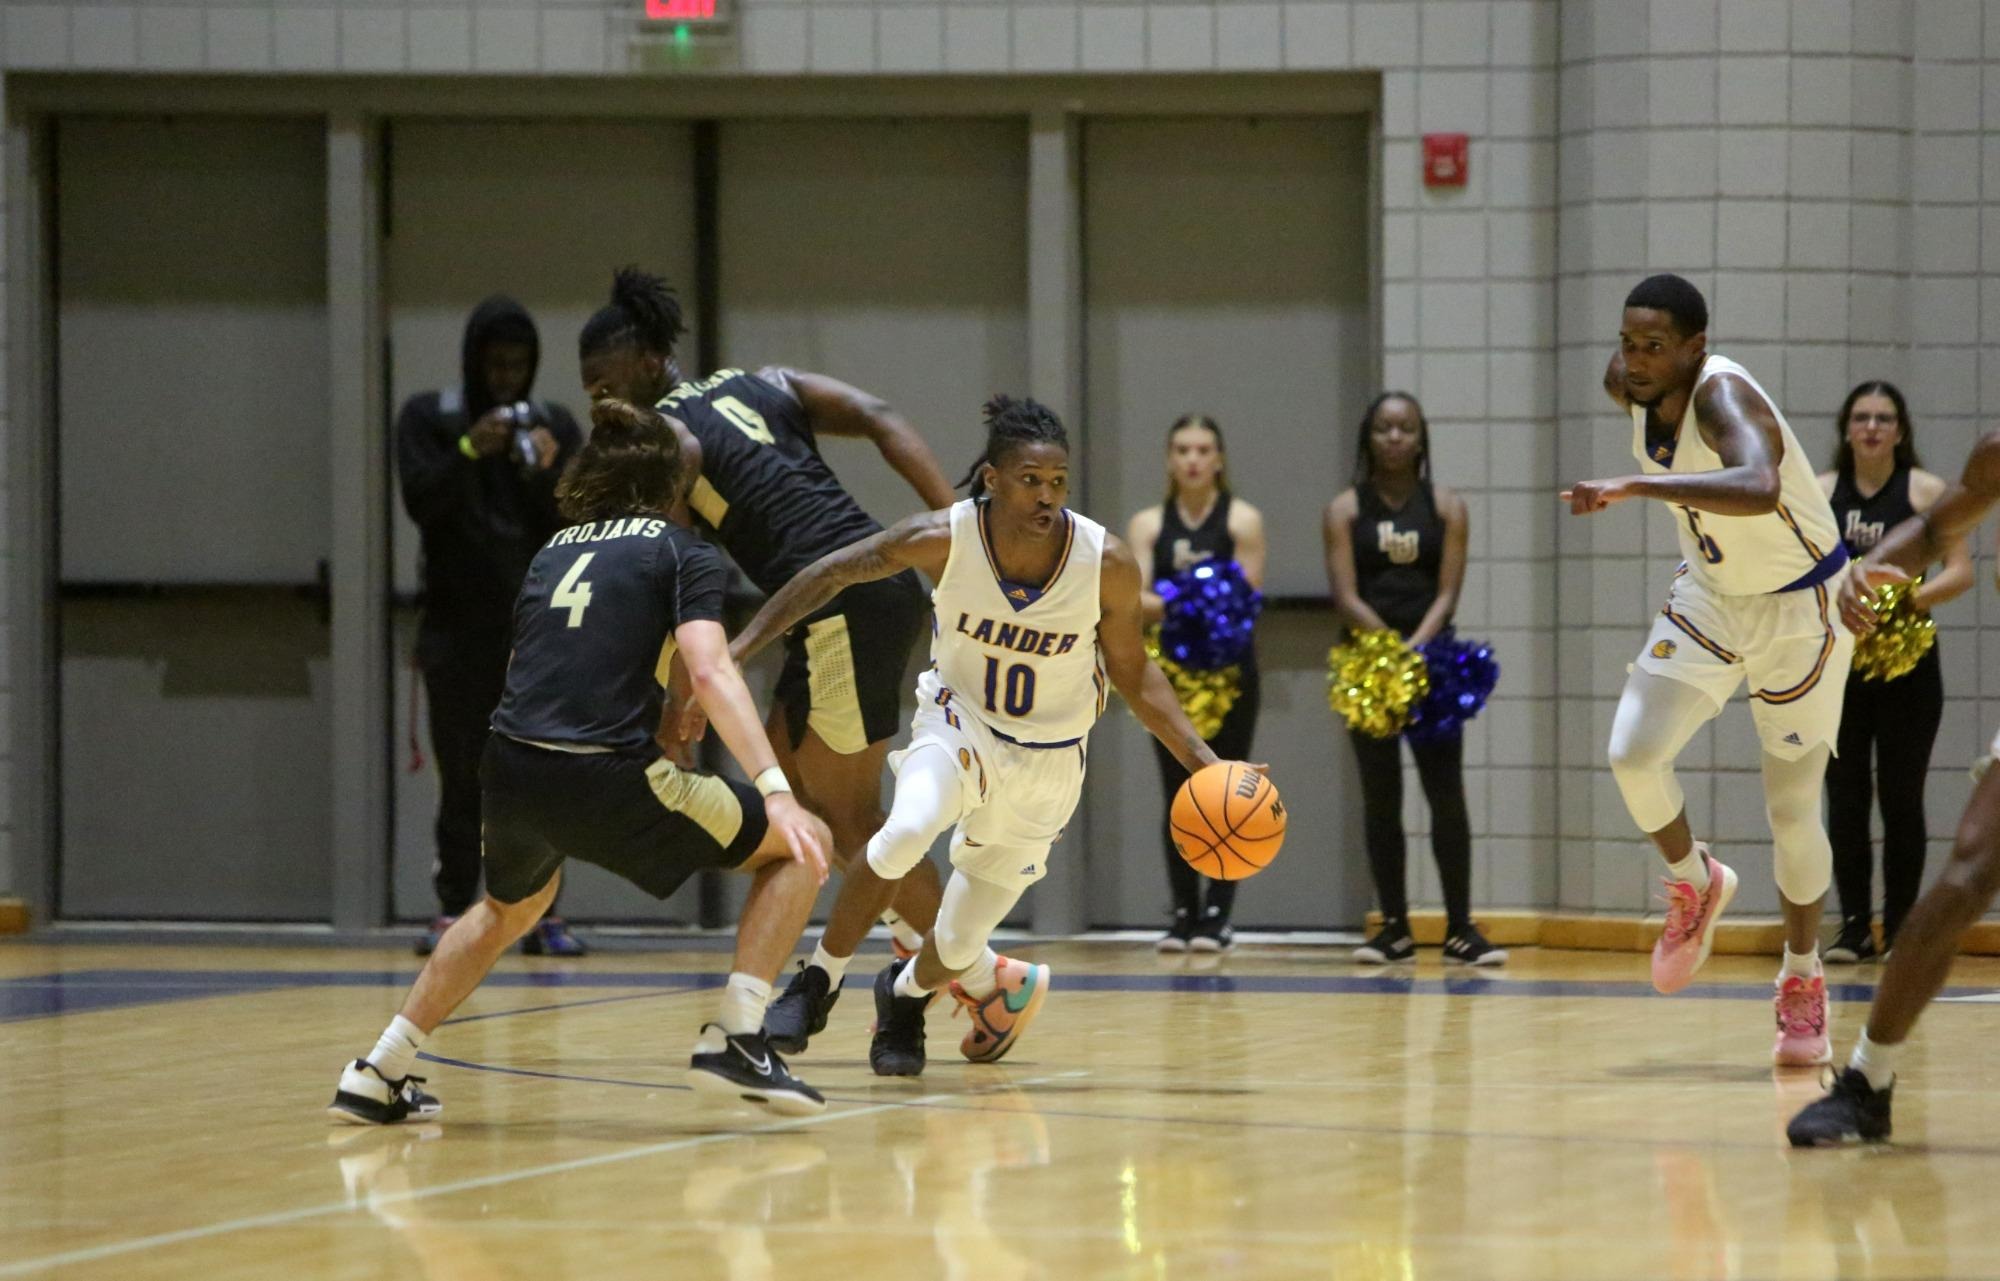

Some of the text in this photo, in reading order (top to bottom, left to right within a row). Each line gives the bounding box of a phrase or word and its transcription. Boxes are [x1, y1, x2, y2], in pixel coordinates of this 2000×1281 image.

[546, 517, 667, 549] TROJANS
[549, 551, 596, 628] 4
[956, 612, 1080, 657] LANDER
[984, 652, 1036, 718] 10
